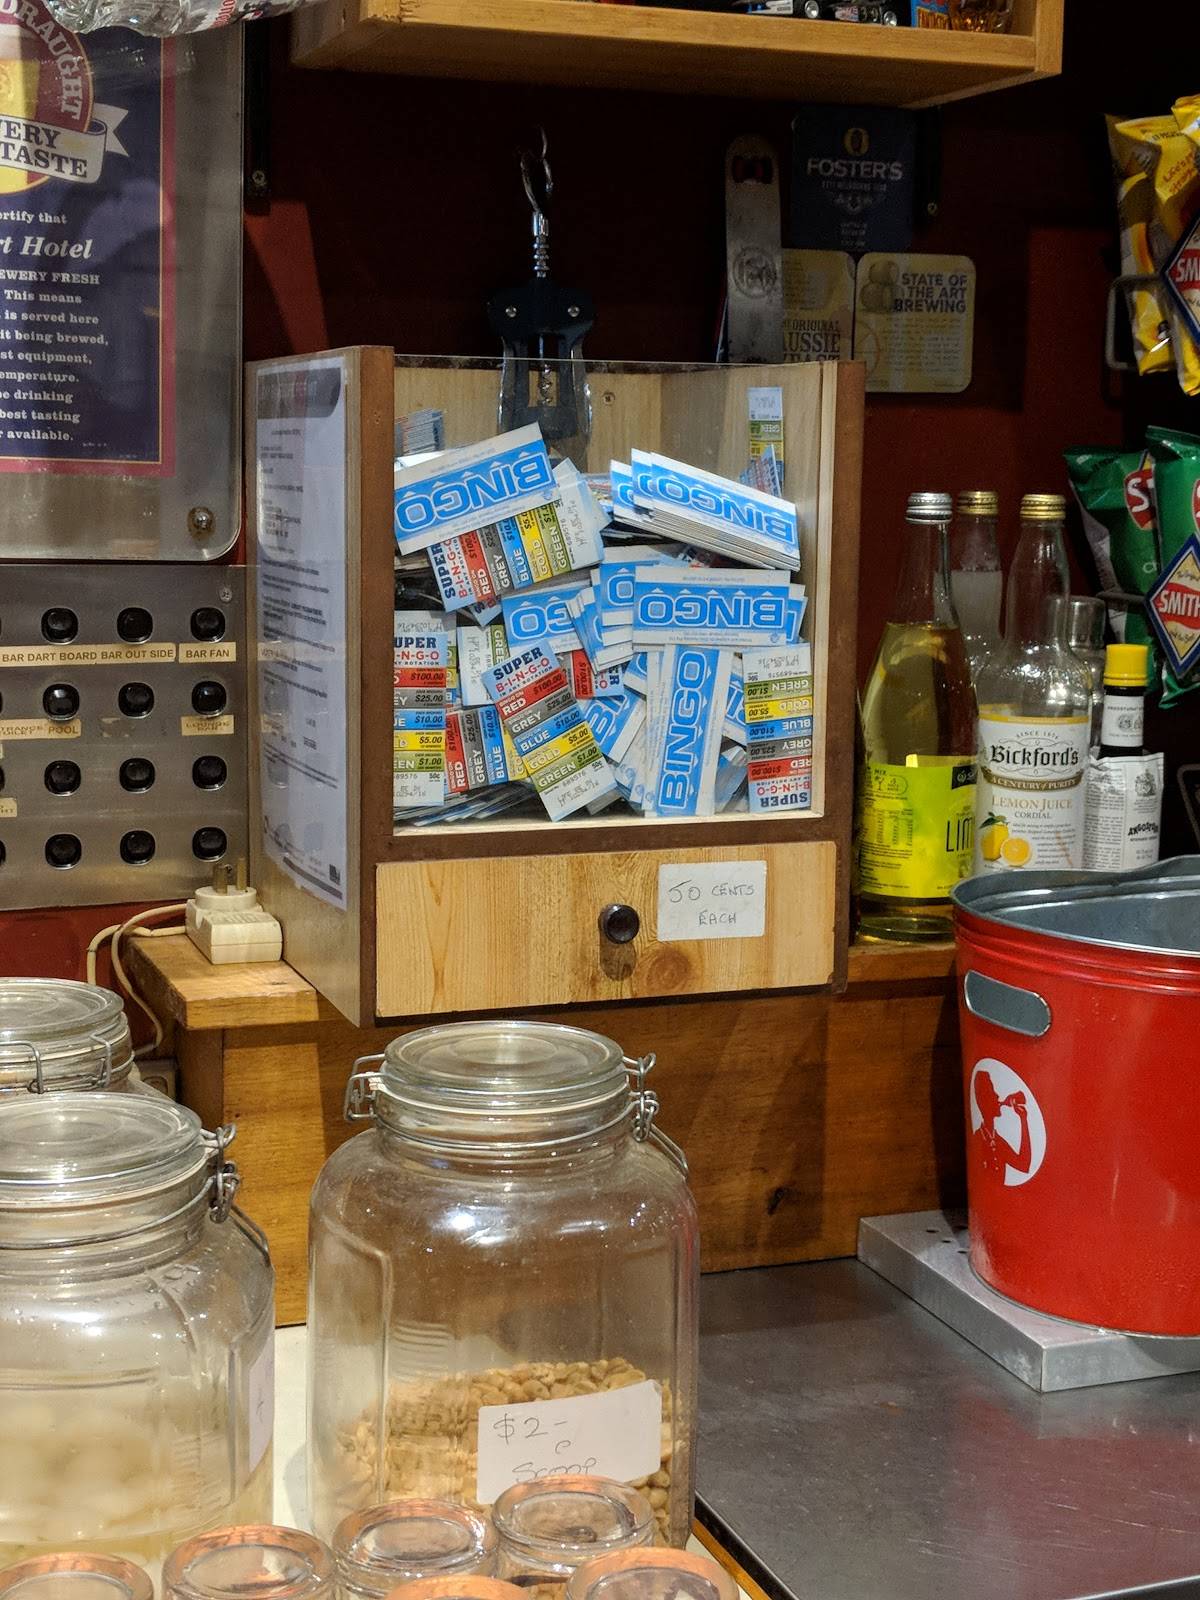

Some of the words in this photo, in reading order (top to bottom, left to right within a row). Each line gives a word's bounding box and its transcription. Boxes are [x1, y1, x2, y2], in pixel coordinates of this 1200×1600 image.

[0, 0, 83, 121] DRAUGHT
[0, 120, 61, 149] ERY
[0, 140, 87, 178] TASTE
[807, 158, 903, 180] FOSTER'S
[38, 212, 67, 224] that
[20, 236, 93, 259] Hotel
[51, 272, 101, 285] FRESH
[902, 273, 943, 286] STATE
[948, 274, 967, 287] OF
[4, 289, 35, 301] This
[38, 293, 82, 304] means
[908, 286, 934, 298] THE
[938, 287, 967, 299] ART
[894, 298, 967, 313] BREWING
[4, 310, 17, 320] is
[21, 312, 65, 323] served
[69, 313, 99, 324] here
[14, 330, 53, 344] being
[56, 332, 109, 346] brewed,
[17, 351, 93, 365] equipment,
[0, 371, 80, 382] emperature.
[0, 391, 10, 400] e
[14, 389, 74, 404] drinking
[0, 409, 27, 420] best
[31, 410, 81, 424] tasting
[7, 430, 74, 441] available.
[395, 451, 552, 533] BINGO
[657, 477, 797, 546] BINGO
[548, 526, 567, 569] GREEN
[513, 547, 529, 582] BLUE
[532, 538, 550, 576] GOLD
[431, 542, 456, 600] SUPER
[493, 554, 511, 588] GREY
[477, 568, 493, 595] RED
[638, 592, 786, 629] BINGO
[394, 637, 437, 648] UPER
[493, 630, 506, 665] GREE
[2, 653, 25, 662] BAR
[27, 652, 56, 661] DART
[59, 651, 97, 661] BOARD
[101, 651, 122, 660] BAR
[125, 650, 147, 659] OUT
[150, 649, 173, 658] SIDE
[186, 649, 207, 658] BAR
[209, 649, 230, 658] FAN
[493, 647, 543, 681] SUPER
[411, 672, 444, 681] $100.00
[495, 657, 550, 693] B-I-N-G-O
[748, 687, 769, 696] $1.00
[772, 679, 809, 691] GREEN
[394, 696, 408, 706] EY
[415, 694, 443, 702] $25.00
[503, 698, 527, 716] RED
[779, 699, 809, 710] GOLD
[415, 715, 443, 724] $10.00
[748, 708, 769, 717] $5.00
[48, 725, 78, 734] POOL
[465, 714, 476, 742] $25.00
[511, 711, 542, 733] GREY
[658, 651, 707, 809] BINGO
[782, 719, 811, 730] BLUE
[750, 727, 775, 736] $10.00
[419, 735, 443, 745] $5.00
[519, 730, 550, 752] BLUE
[782, 738, 811, 750] GREY
[529, 749, 561, 770] GOLD
[568, 728, 589, 745] $5.00
[990, 744, 1080, 767] Bickford's
[394, 759, 415, 769] EEN
[419, 757, 442, 766] $1.00
[472, 749, 486, 783] GREY
[492, 746, 505, 779] BLUE
[515, 757, 526, 775] GO
[538, 761, 577, 788] GREEN
[576, 747, 598, 763] $1.00
[751, 765, 782, 776] $100.00
[790, 759, 812, 769] RED
[454, 761, 466, 787] RED
[998, 777, 1040, 790] CENTURY
[1048, 779, 1077, 789] PURITY
[760, 791, 808, 808] SUPER
[992, 796, 1040, 809] LEMON
[1042, 798, 1073, 812] JUICE
[1014, 811, 1053, 819] CORDIAL
[946, 815, 975, 852] LIM
[668, 879, 701, 903] 50
[711, 882, 755, 897] CENTS
[698, 909, 737, 926] EACH
